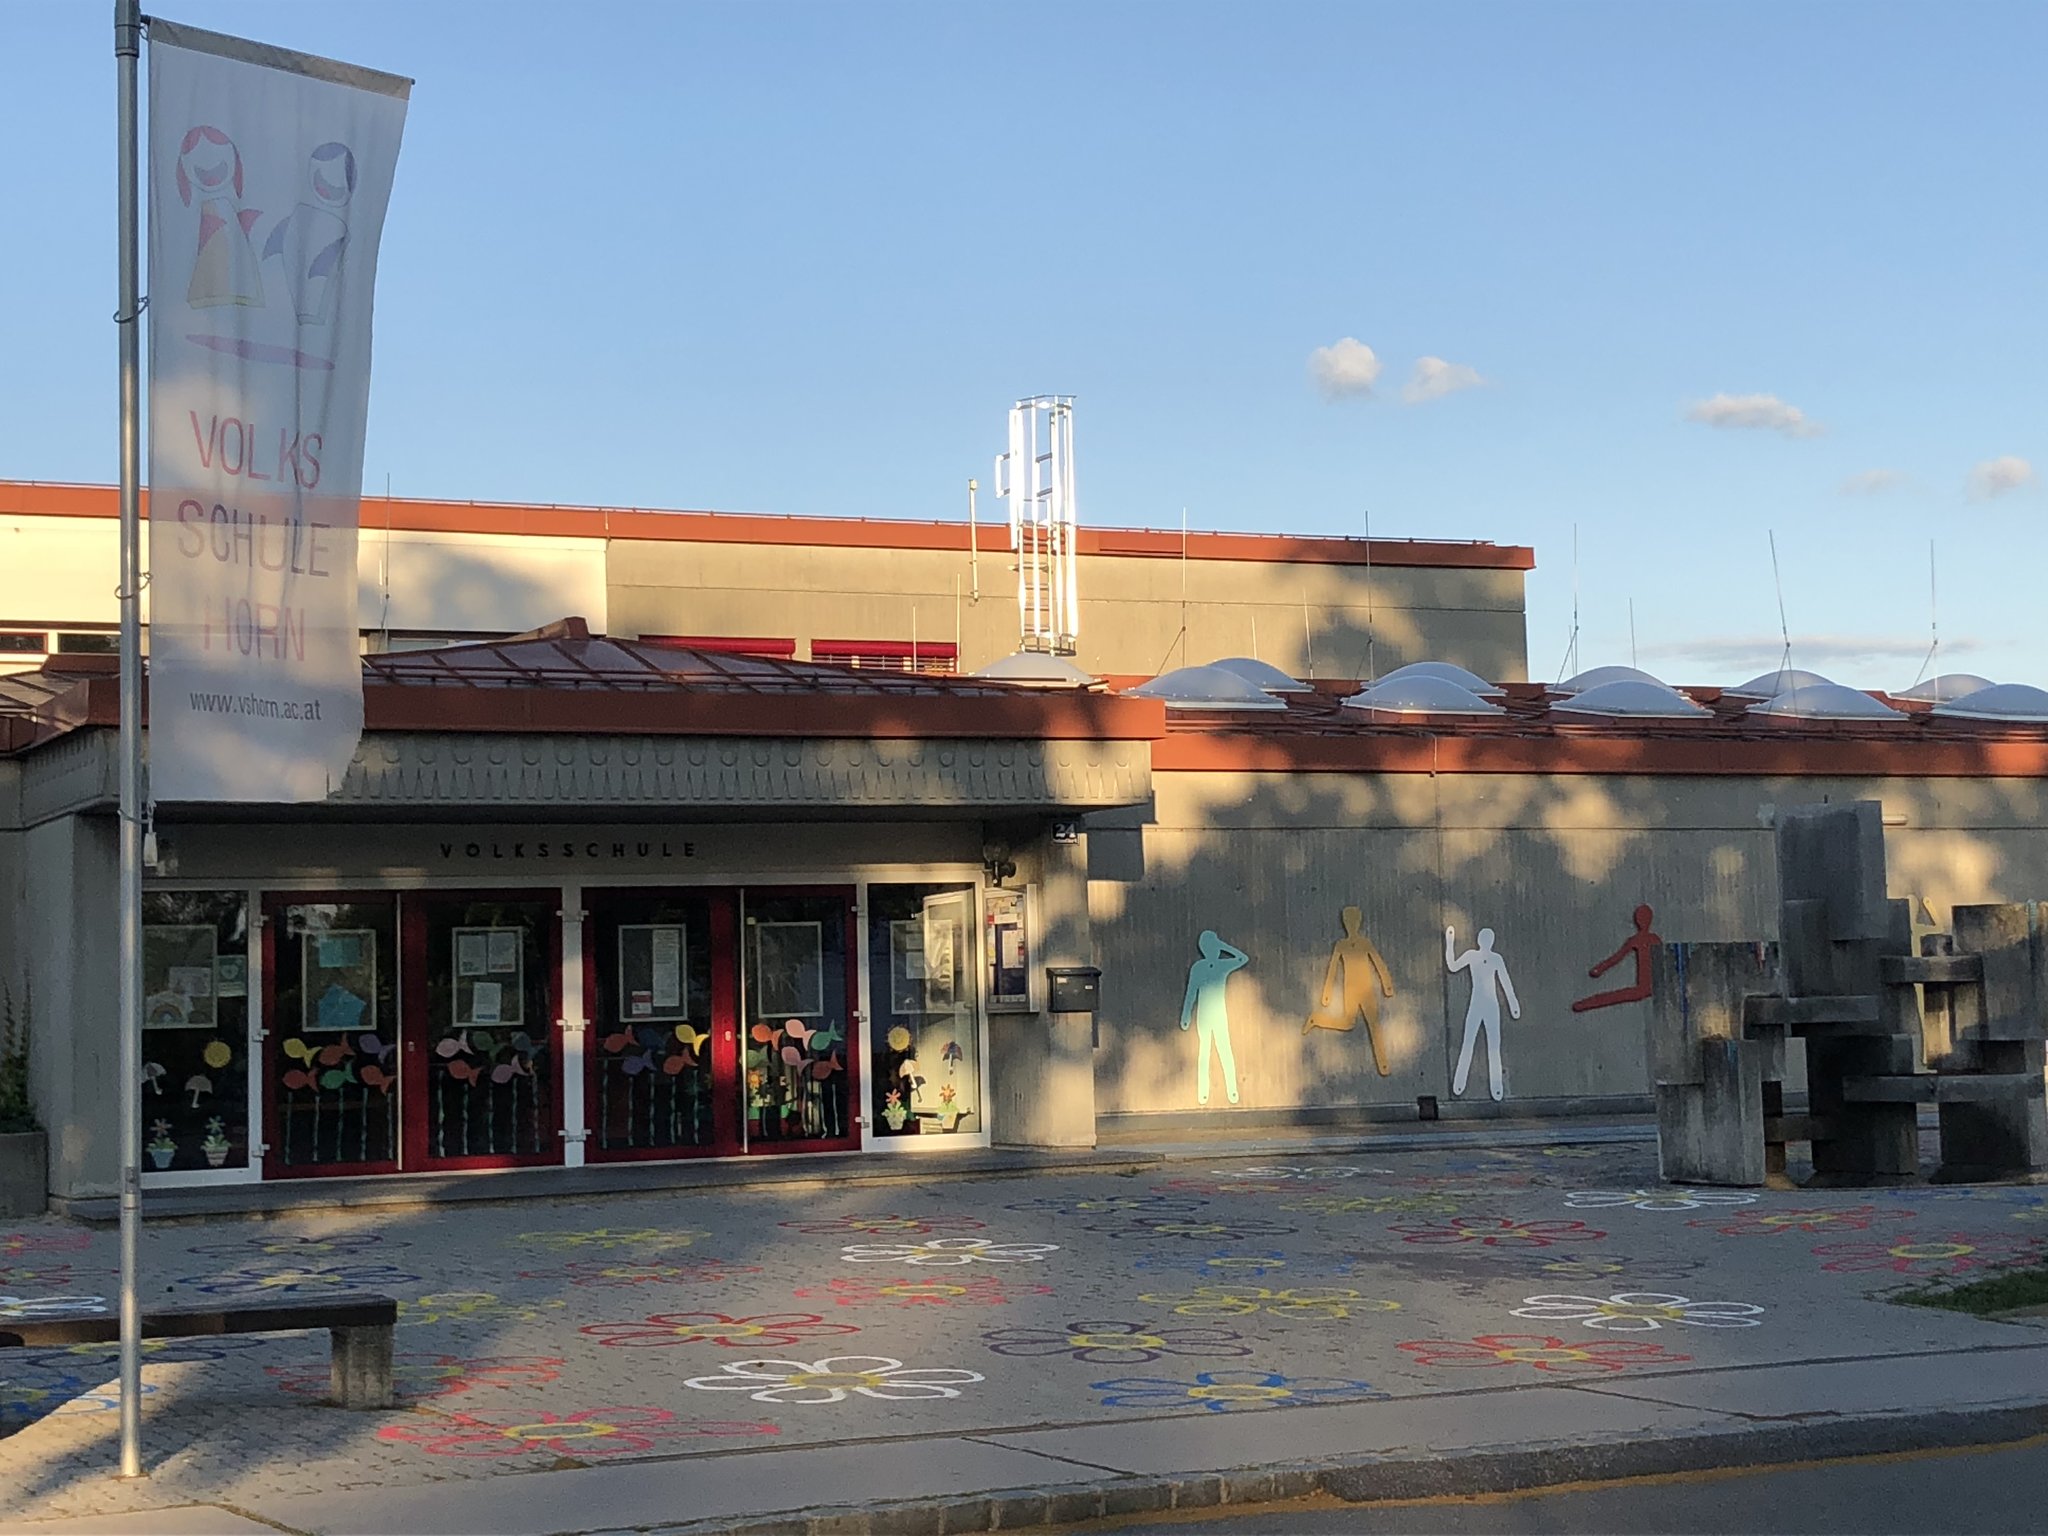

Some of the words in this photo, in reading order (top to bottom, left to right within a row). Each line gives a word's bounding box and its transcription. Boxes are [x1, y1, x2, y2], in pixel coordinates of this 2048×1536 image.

[189, 410, 323, 490] VOLKS
[176, 498, 331, 578] SCHULE
[203, 596, 306, 662] HORN
[440, 842, 695, 859] VOLKSSCHULE
[1055, 823, 1076, 838] 24
